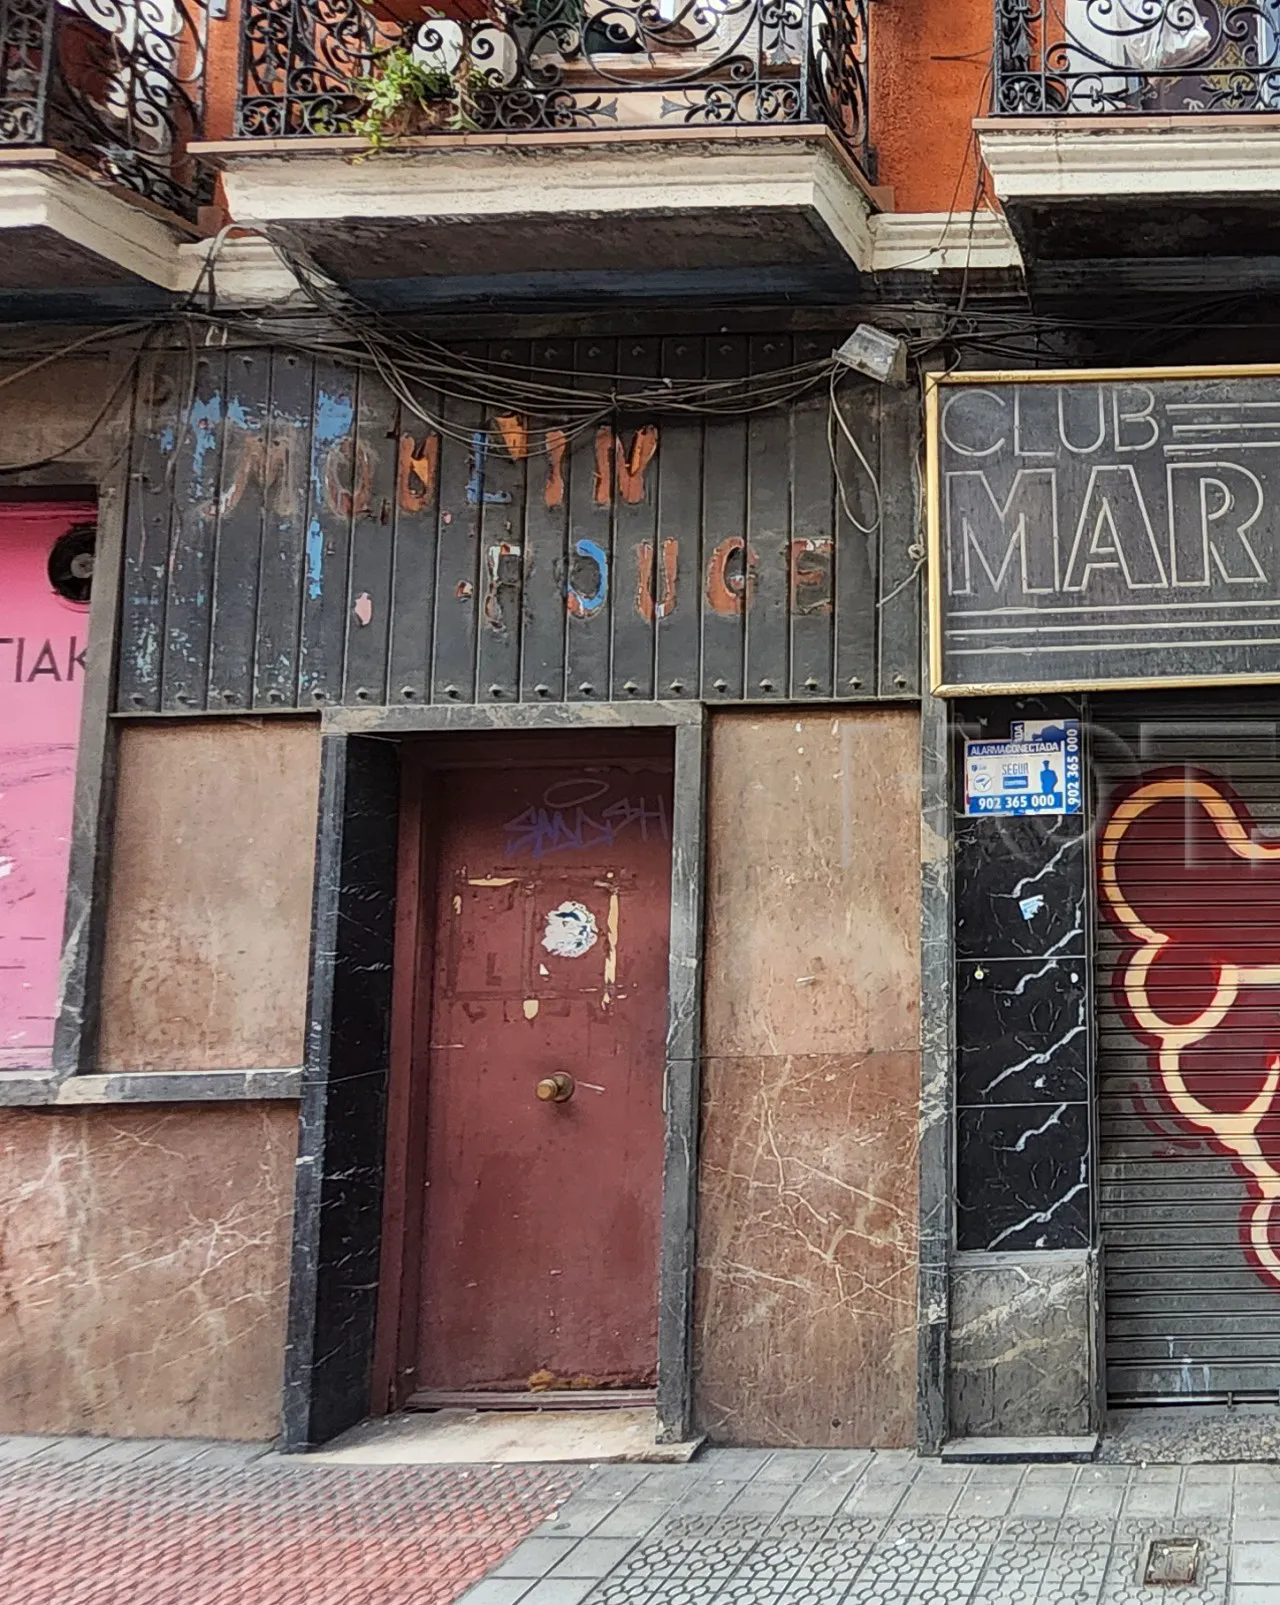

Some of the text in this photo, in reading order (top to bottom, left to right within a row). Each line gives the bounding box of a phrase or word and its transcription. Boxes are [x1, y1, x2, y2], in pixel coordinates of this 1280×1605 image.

[941, 386, 1159, 457] CLUB
[978, 794, 1055, 810] 902 365 000
[1066, 728, 1081, 806] 902 365 000
